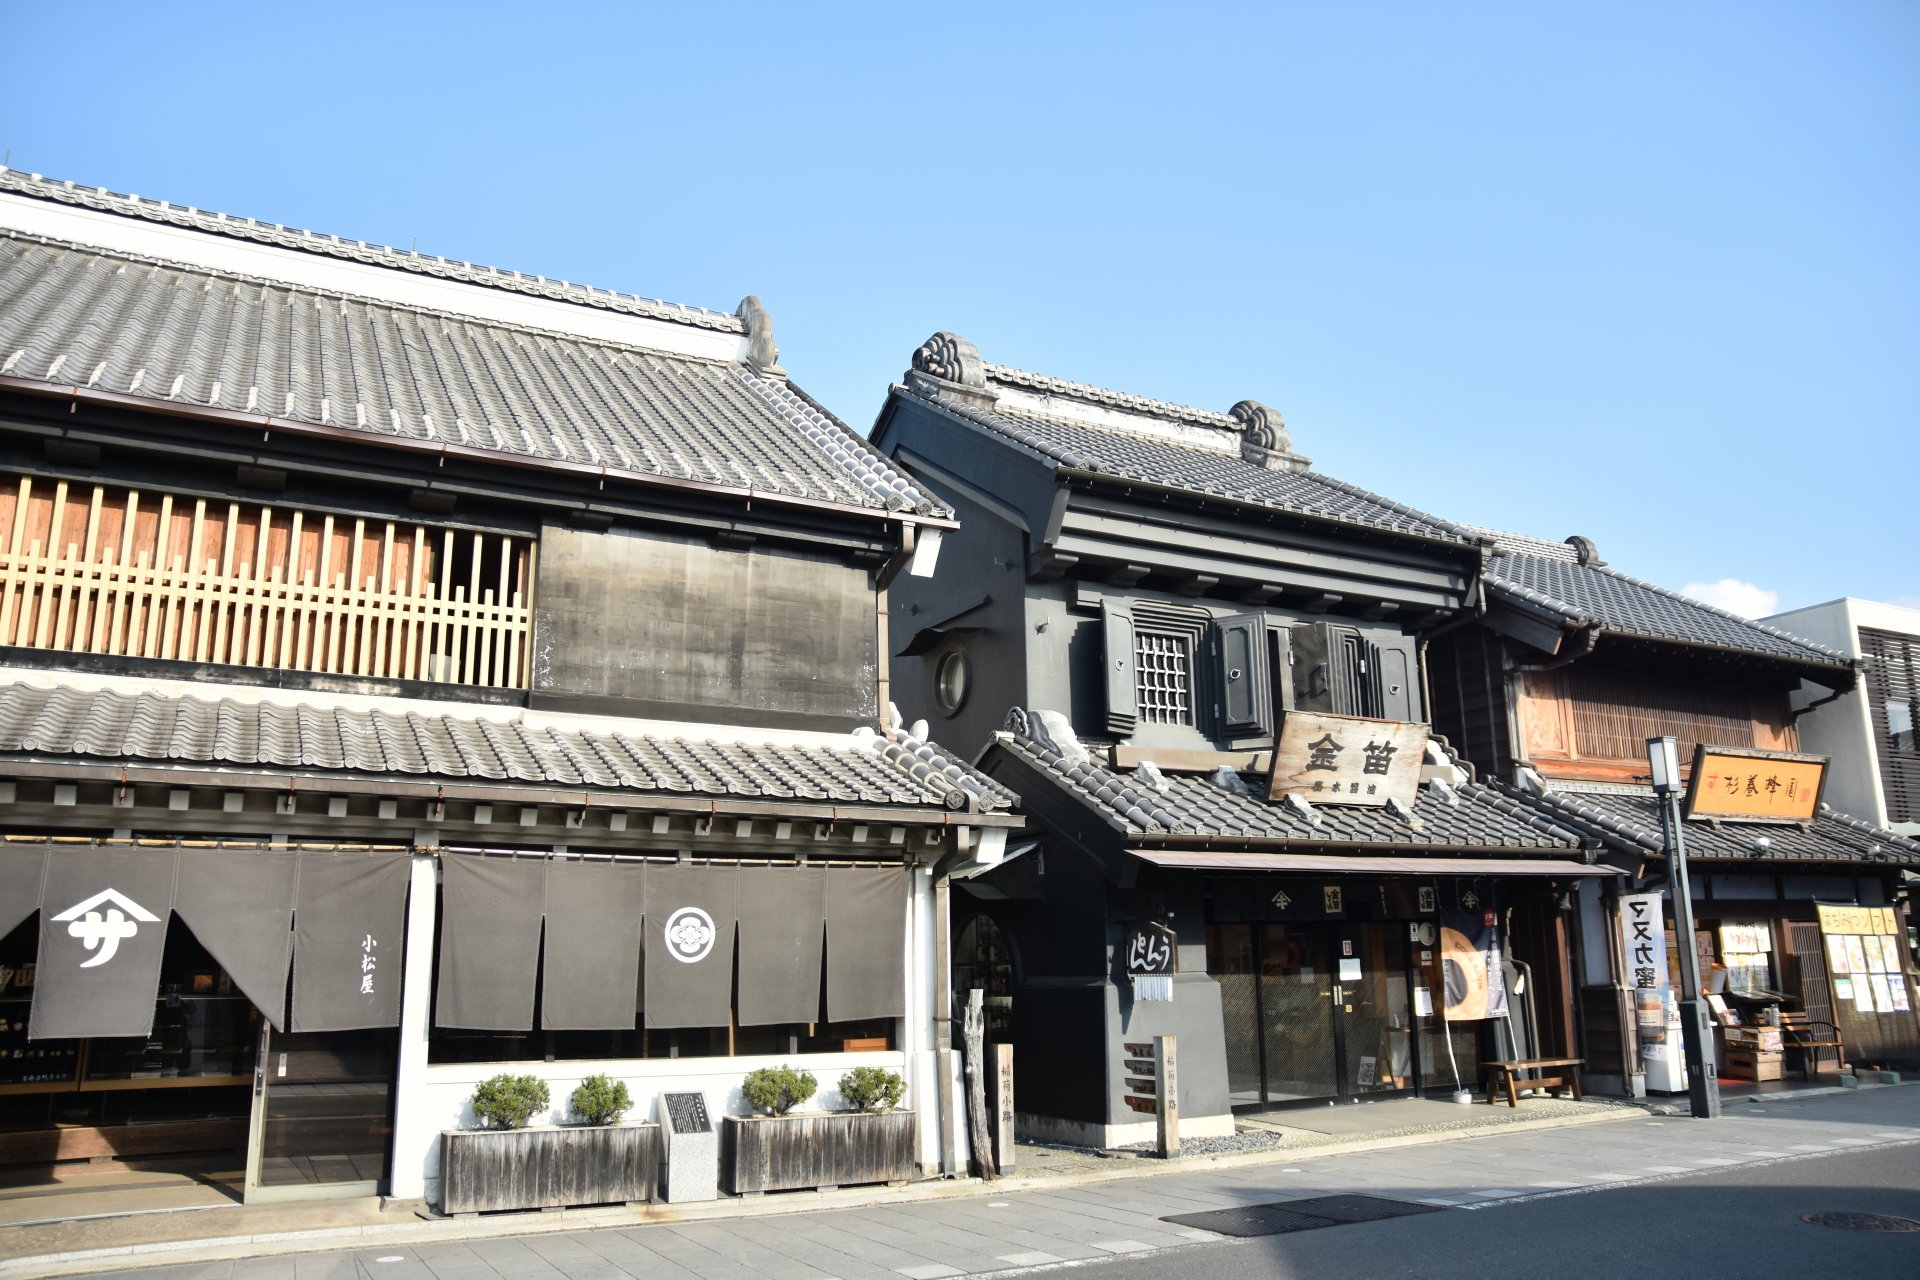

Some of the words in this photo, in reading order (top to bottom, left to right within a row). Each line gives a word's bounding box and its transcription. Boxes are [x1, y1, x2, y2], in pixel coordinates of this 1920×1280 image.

[1305, 732, 1399, 775] 金笛
[1821, 911, 1894, 928] はちみつソフト
[359, 934, 377, 994] 小松屋
[1001, 1064, 1012, 1122] 稲荷小路
